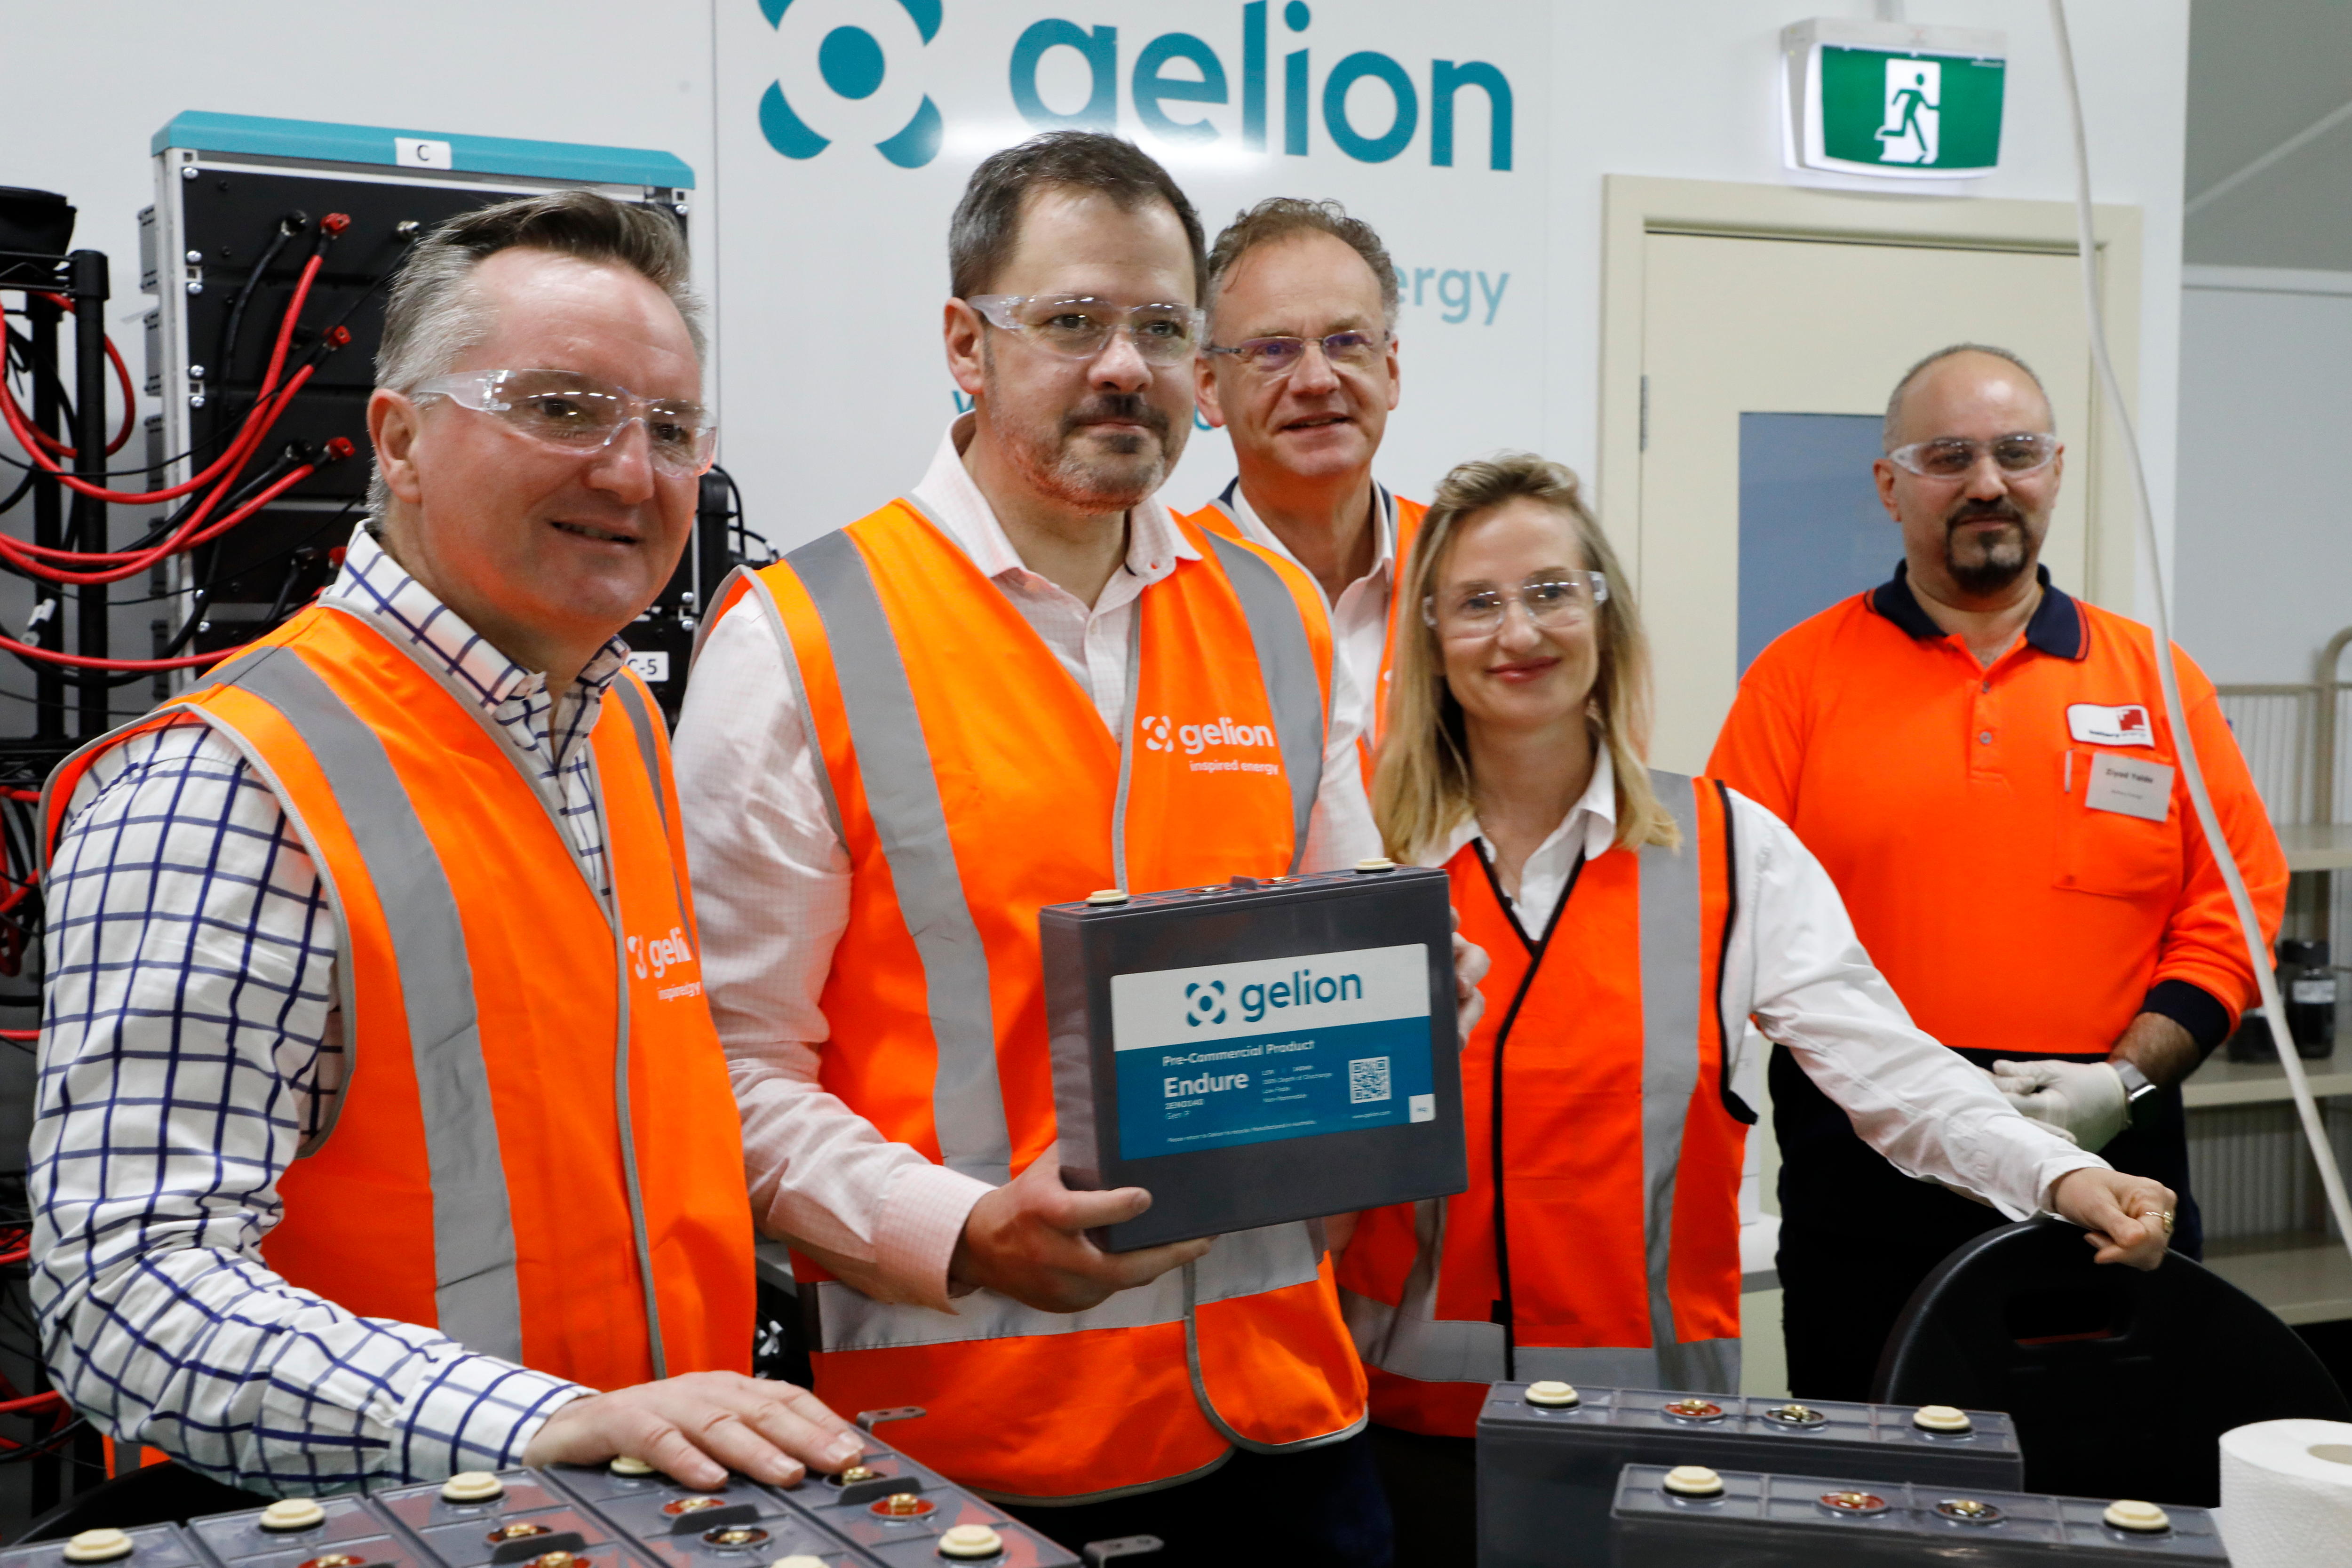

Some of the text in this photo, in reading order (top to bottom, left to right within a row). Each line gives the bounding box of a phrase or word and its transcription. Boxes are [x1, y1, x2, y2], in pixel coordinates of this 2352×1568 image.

[416, 144, 429, 161] C
[1179, 716, 1275, 755] gelion
[1189, 759, 1279, 775] inspired energy
[1240, 969, 1362, 1023] gelion
[1162, 1039, 1316, 1067] Pre-Commercial Product
[1164, 1072, 1250, 1098] Endure
